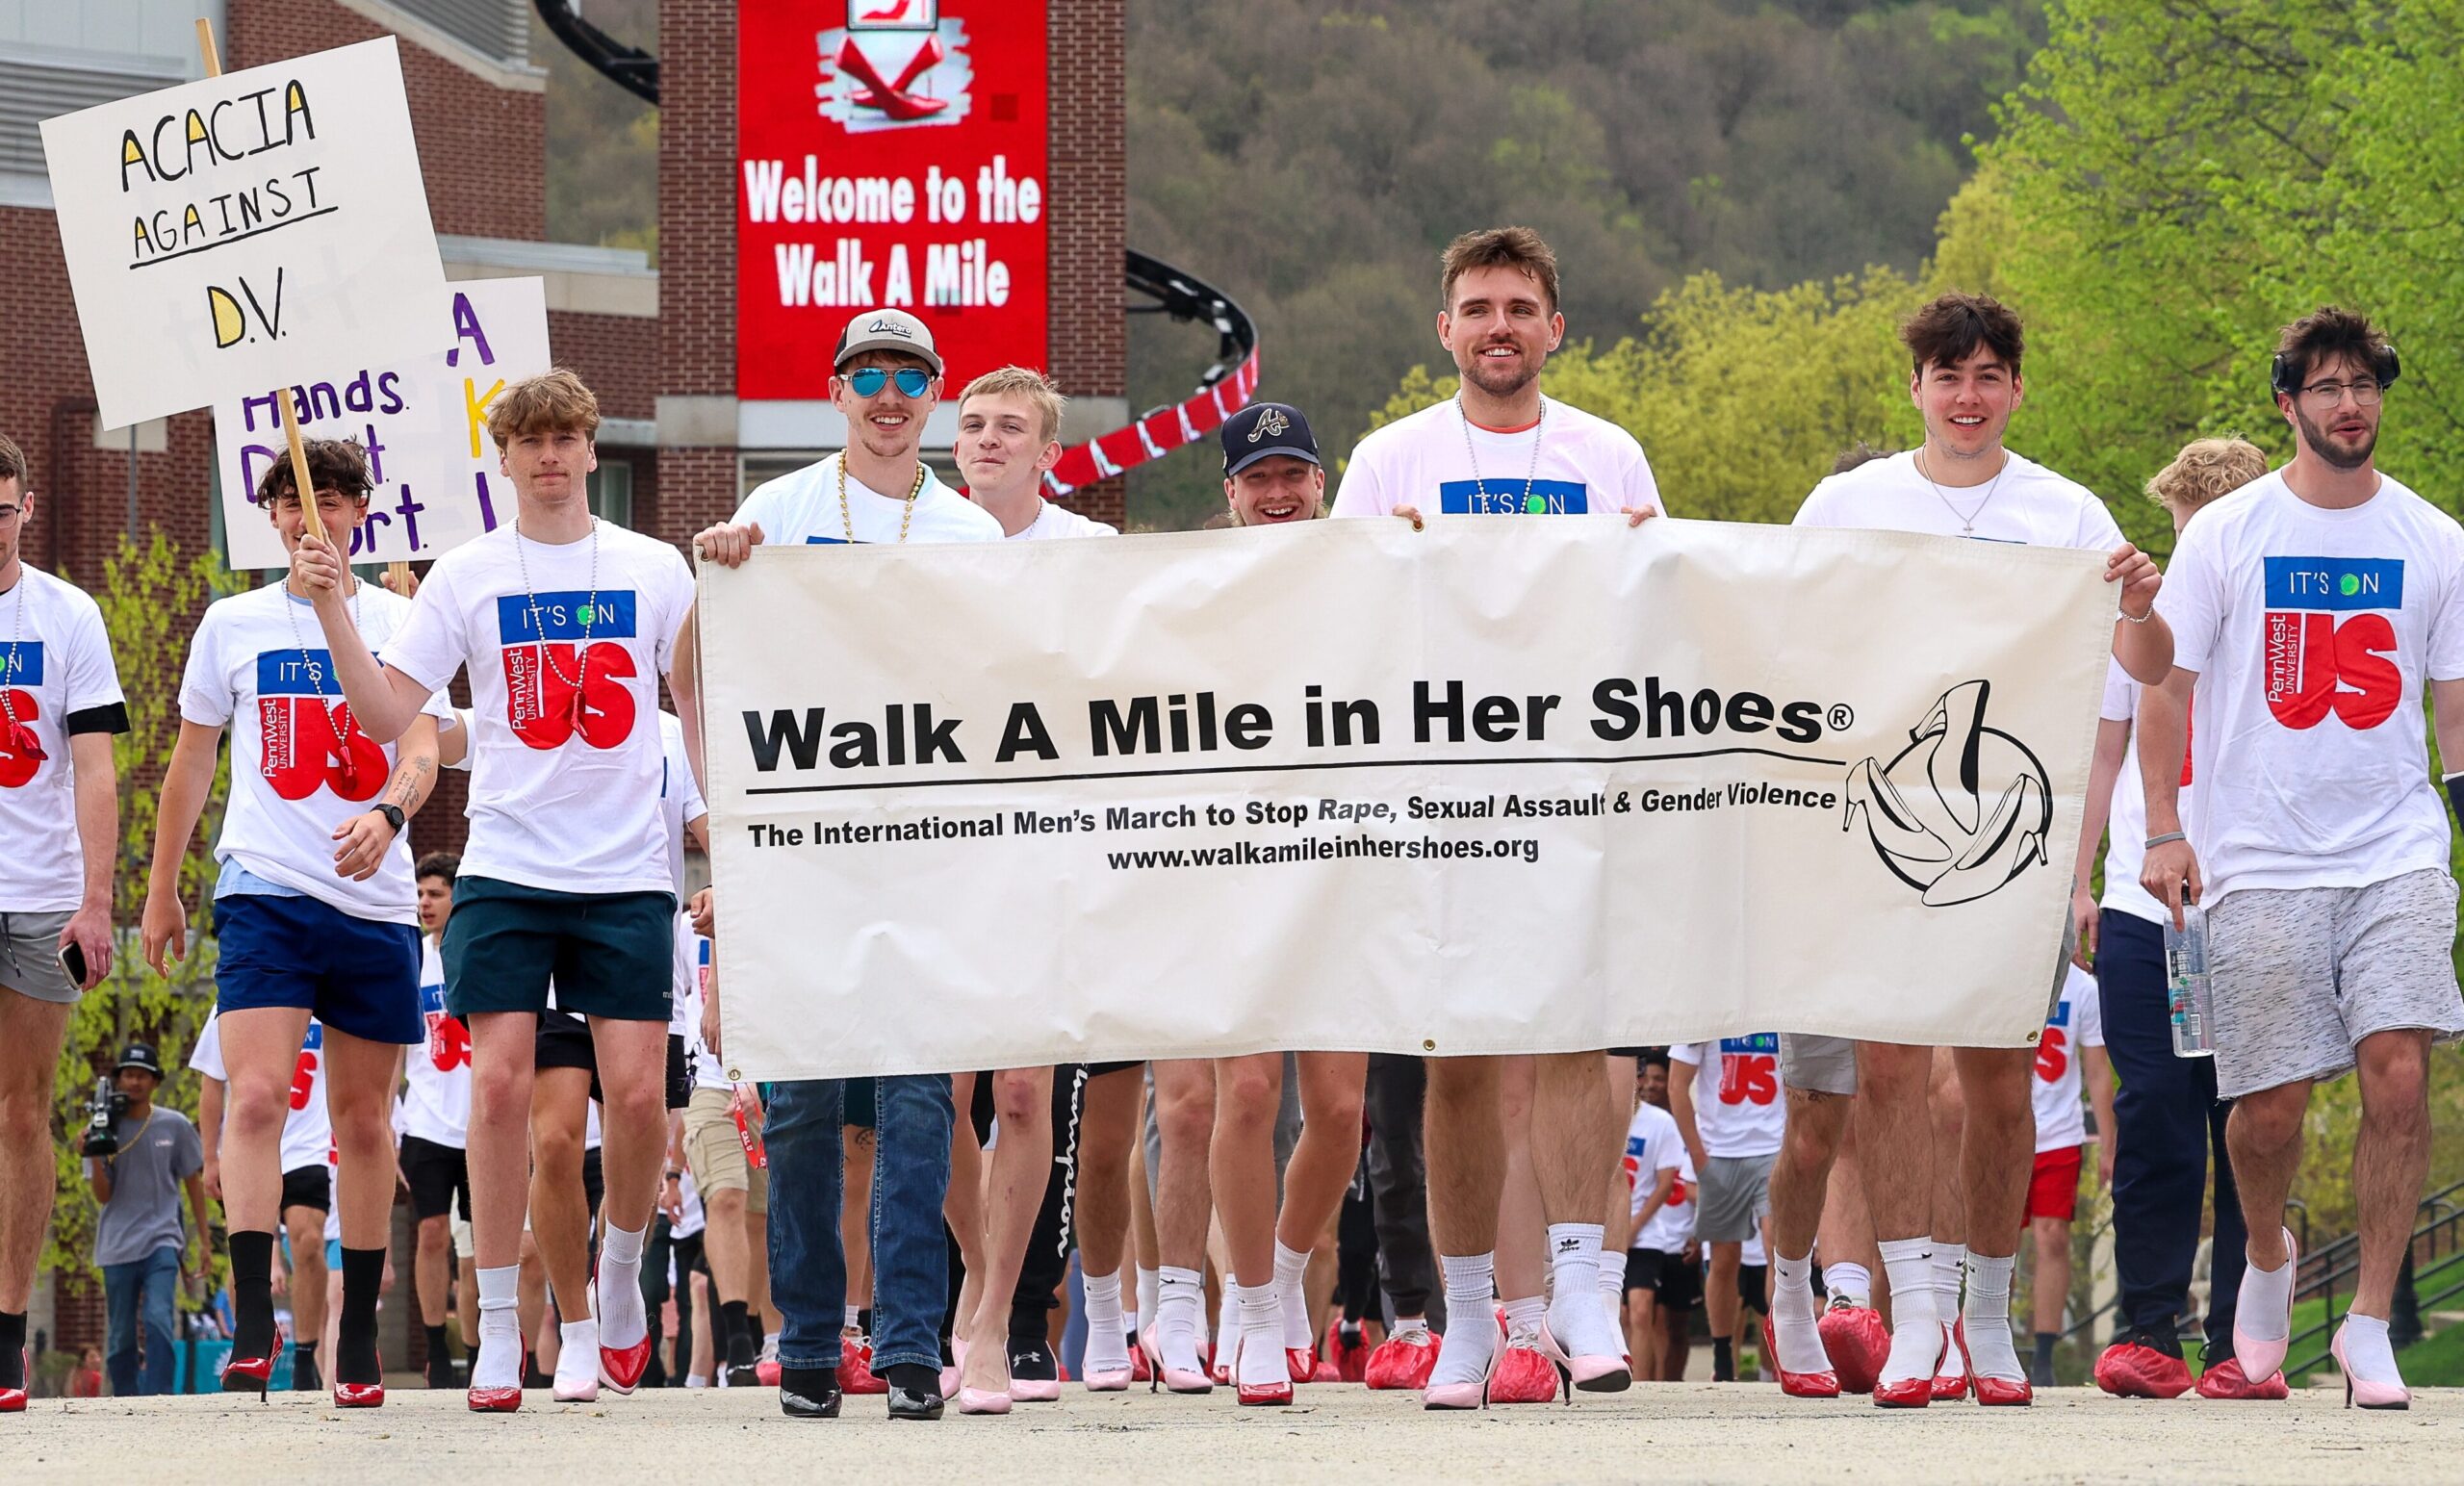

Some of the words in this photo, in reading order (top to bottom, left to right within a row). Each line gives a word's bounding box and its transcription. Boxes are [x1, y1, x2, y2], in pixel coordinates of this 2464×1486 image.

[121, 79, 316, 192] ACACIA
[135, 167, 321, 258] AGAINST
[743, 154, 915, 224] Welcome
[926, 166, 966, 224] to
[977, 154, 1041, 224] the
[207, 267, 287, 348] D.V.
[774, 238, 874, 307] Walk
[885, 243, 913, 307] A
[924, 238, 1010, 307] Mile
[1468, 493, 1515, 514] IT'S
[523, 604, 567, 629] IT'S
[2290, 572, 2329, 595] IT'S
[280, 662, 322, 682] IT'S
[508, 648, 526, 730] PennWest
[526, 656, 537, 721] UNIVERSITY
[2264, 612, 2402, 730] US
[2268, 615, 2286, 704] PennWest
[2285, 625, 2298, 695] UNIVERSITY
[501, 641, 637, 751] US
[742, 703, 967, 772] Walk
[994, 702, 1060, 762] A
[1089, 691, 1273, 756] Mile
[1305, 684, 1380, 748] in
[1412, 680, 1561, 743] Her
[263, 699, 277, 778] PennWest
[279, 707, 288, 770] UNIVERSITY
[747, 824, 804, 848] The
[814, 812, 1003, 845] International
[1014, 809, 1096, 835] Men's
[1106, 804, 1196, 831] March
[1206, 804, 1236, 827] to
[1245, 801, 1308, 828] Stop
[1318, 797, 1398, 824] Rape,
[1407, 796, 1495, 820] Sexual
[1502, 792, 1605, 818] Assault
[1613, 794, 1631, 813] &
[1641, 788, 1722, 813] Gender
[1727, 782, 1836, 809] Violence
[1108, 835, 1540, 869] www.walkamileinhershoes.org
[1055, 1063, 1088, 1259] hampion
